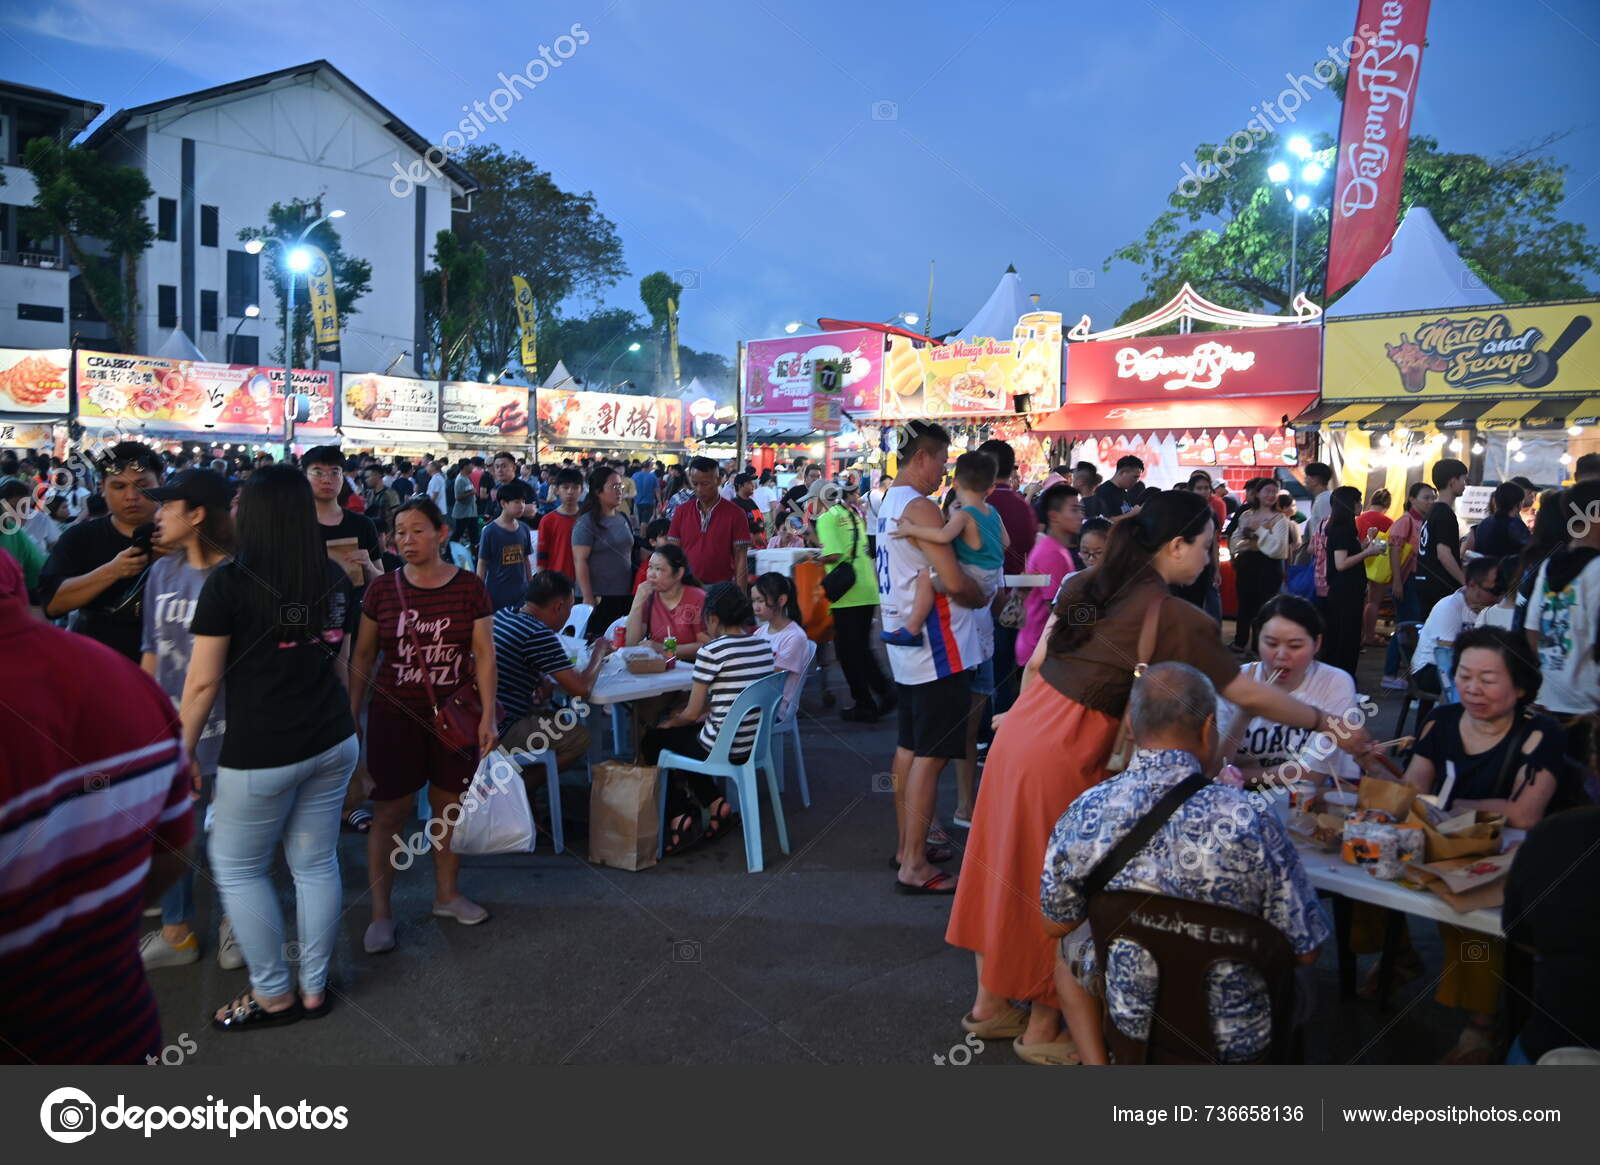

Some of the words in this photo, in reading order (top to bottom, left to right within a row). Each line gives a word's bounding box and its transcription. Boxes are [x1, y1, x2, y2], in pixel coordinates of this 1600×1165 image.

[1417, 317, 1504, 351] Match
[1482, 329, 1537, 354] and
[1447, 350, 1533, 381] Scoop
[421, 636, 461, 663] the
